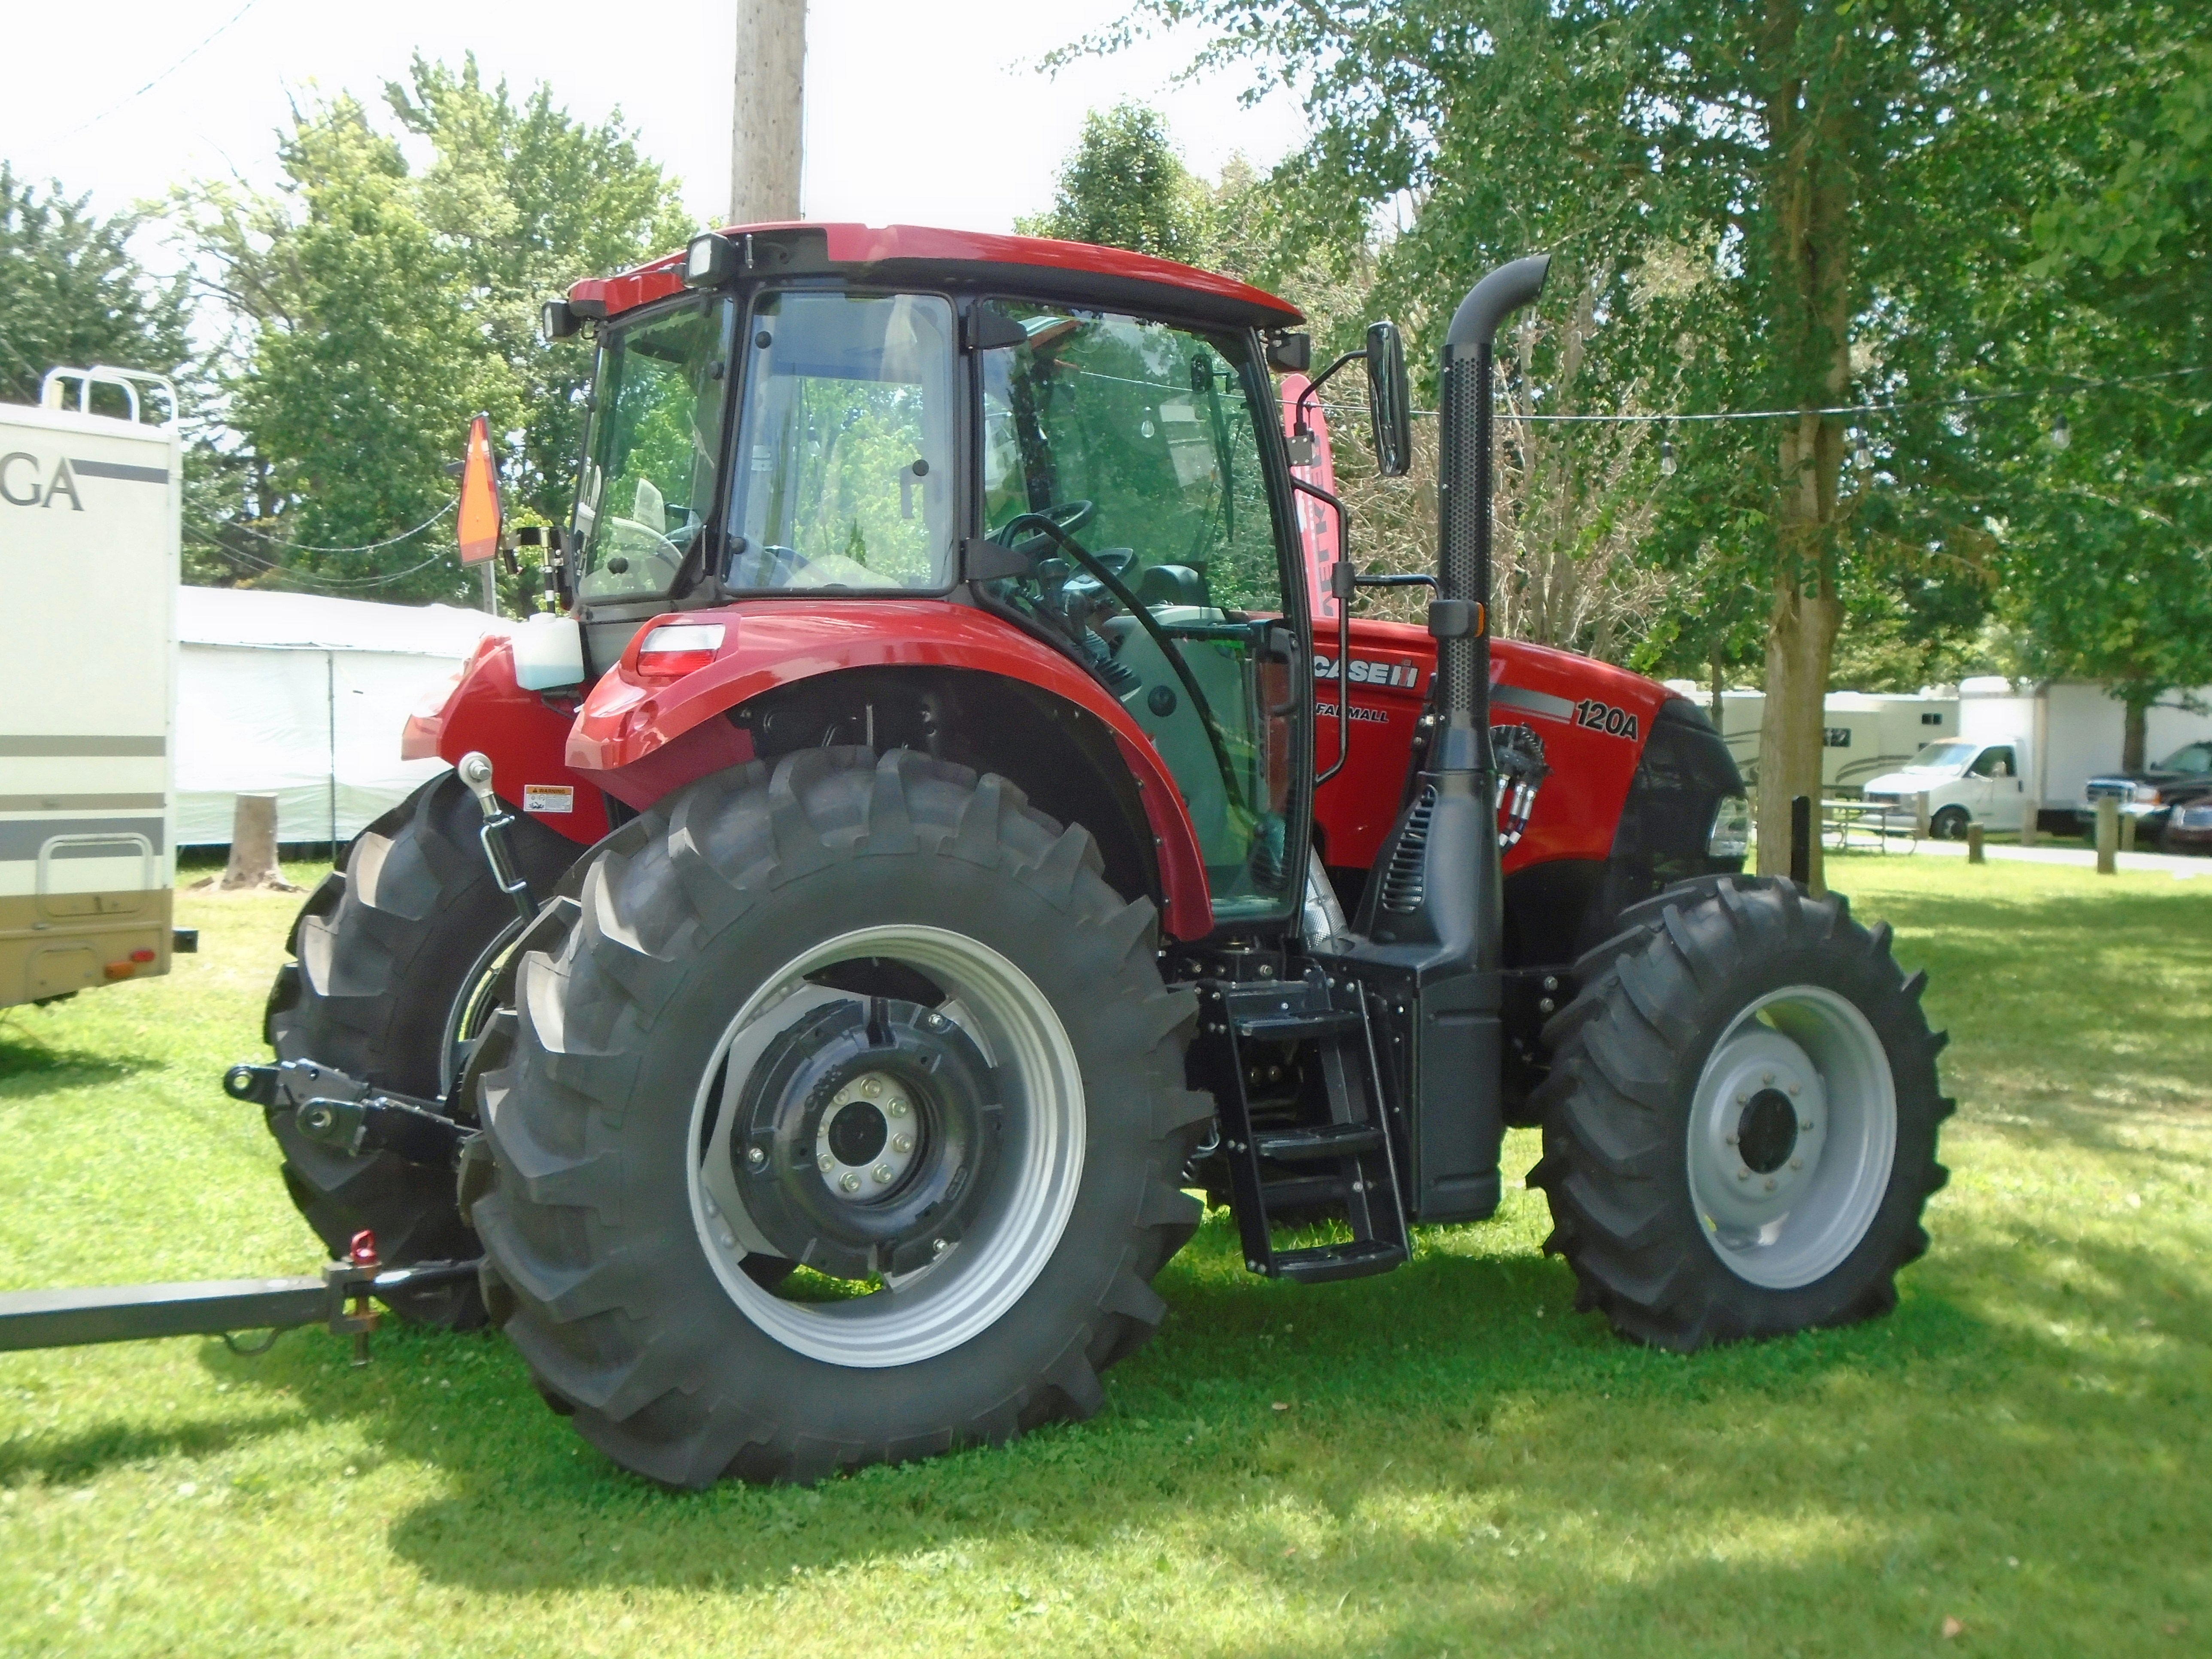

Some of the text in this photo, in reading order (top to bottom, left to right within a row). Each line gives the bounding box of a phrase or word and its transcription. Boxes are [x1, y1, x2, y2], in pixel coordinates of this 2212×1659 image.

[0, 452, 85, 511] GA
[1316, 702, 1389, 723] FAMALL
[1577, 698, 1638, 741] 120A
